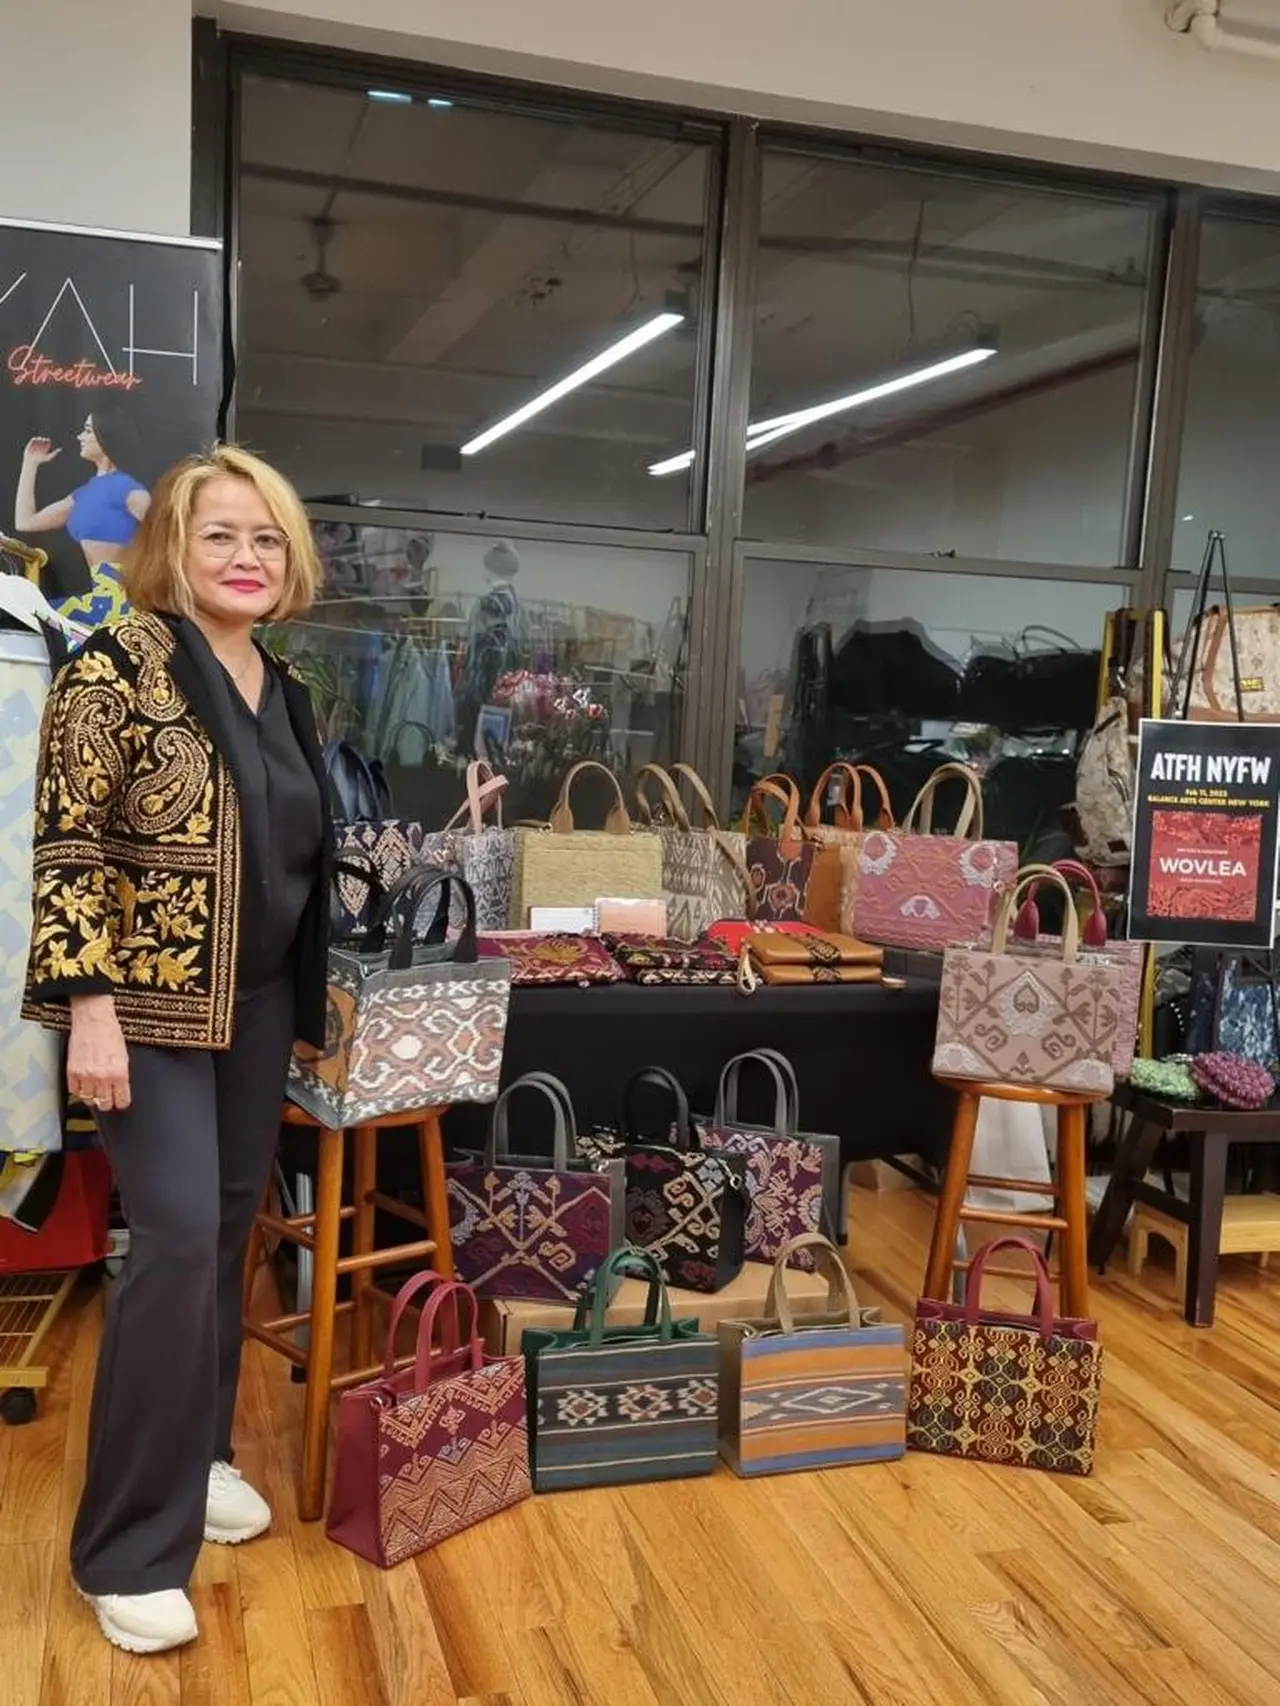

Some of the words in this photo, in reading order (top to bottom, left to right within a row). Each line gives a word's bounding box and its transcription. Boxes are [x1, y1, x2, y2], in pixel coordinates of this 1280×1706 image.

[1150, 752, 1202, 781] ATFH
[1206, 755, 1272, 784] NYFW
[1147, 794, 1178, 803] BALANCE
[1179, 796, 1197, 805] ARTS
[1198, 797, 1226, 806] CENTER
[1228, 799, 1247, 807] NEW
[1249, 799, 1271, 808] YORK
[1160, 857, 1247, 877] WOVLEA
